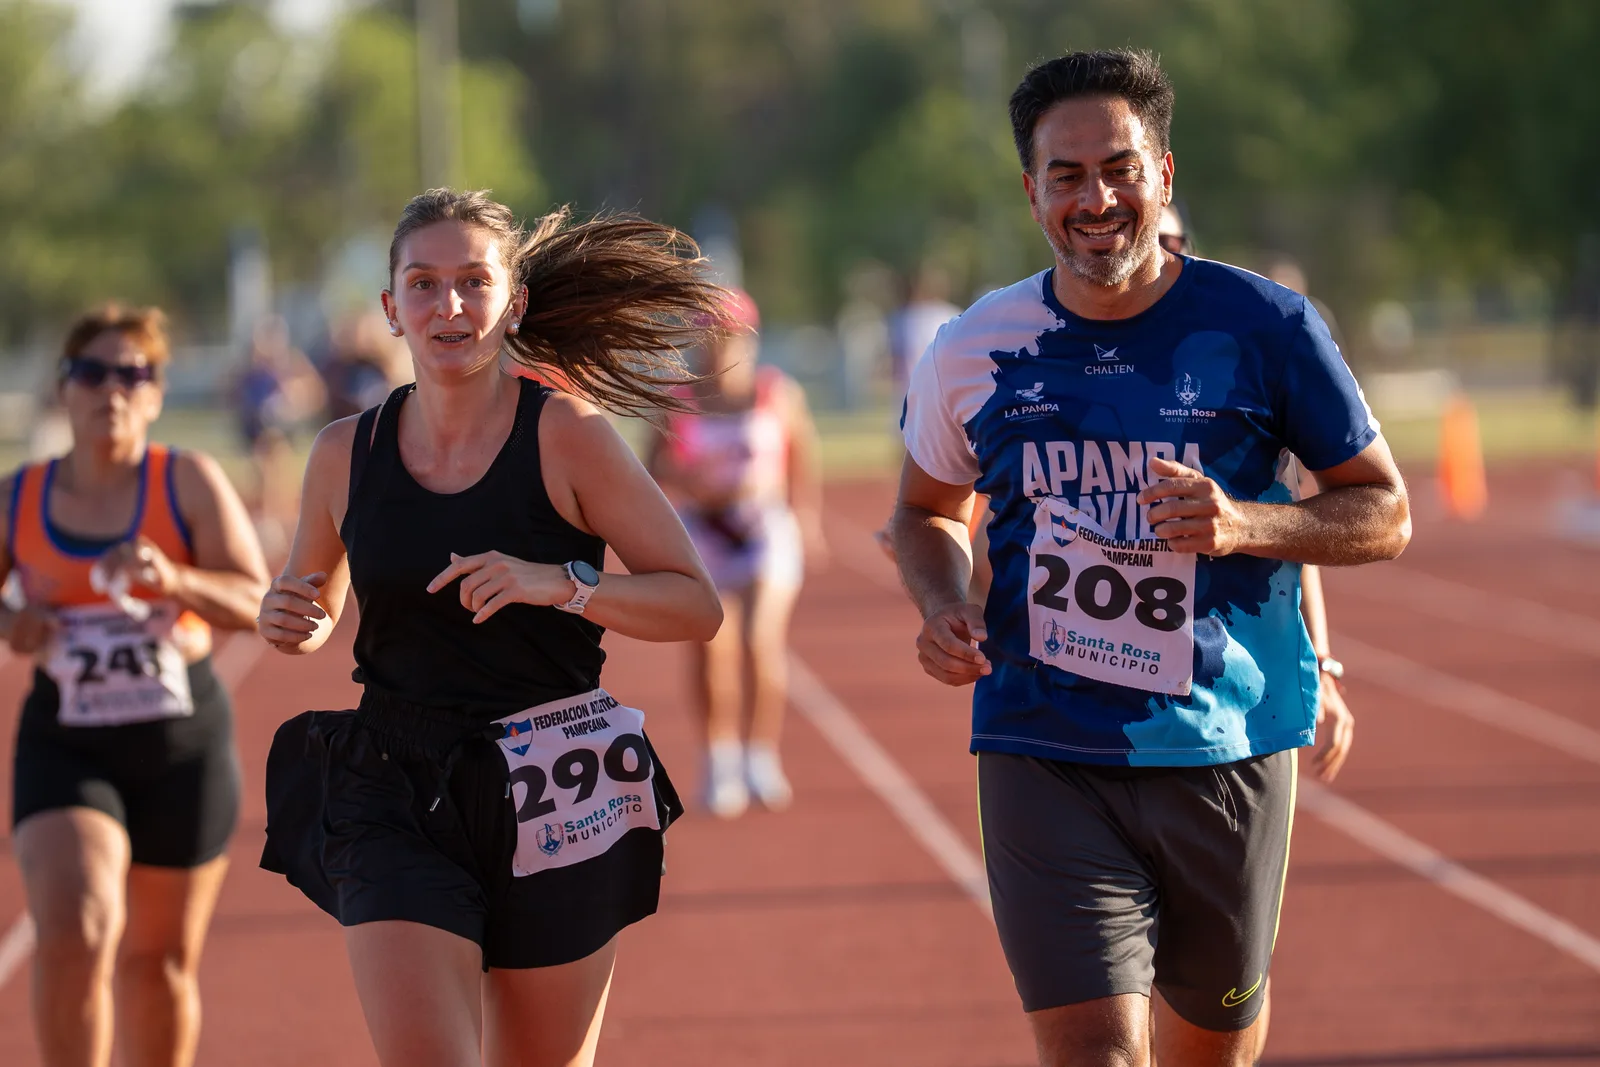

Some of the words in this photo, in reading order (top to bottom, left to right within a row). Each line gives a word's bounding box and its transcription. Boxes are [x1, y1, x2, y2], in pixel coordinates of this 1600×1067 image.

[1084, 364, 1135, 375] CHALTEN
[1004, 408, 1019, 419] LA
[1021, 403, 1060, 415] PAMPA
[1159, 407, 1189, 417] Santa
[1191, 408, 1217, 418] Rosa
[1164, 417, 1209, 425] MUNICIPIO
[1078, 525, 1135, 551] FEDERACION
[1032, 554, 1188, 632] 208
[1065, 644, 1159, 676] MUNICIPIO
[1066, 629, 1115, 653] Santa
[1121, 642, 1161, 663] Rosa
[533, 703, 590, 732] FEDERACION
[562, 716, 611, 740] PAMPEANA
[510, 733, 651, 824] 290
[564, 808, 607, 834] Santa
[607, 793, 642, 811] Rosa
[567, 803, 643, 845] MUNICIPIO
